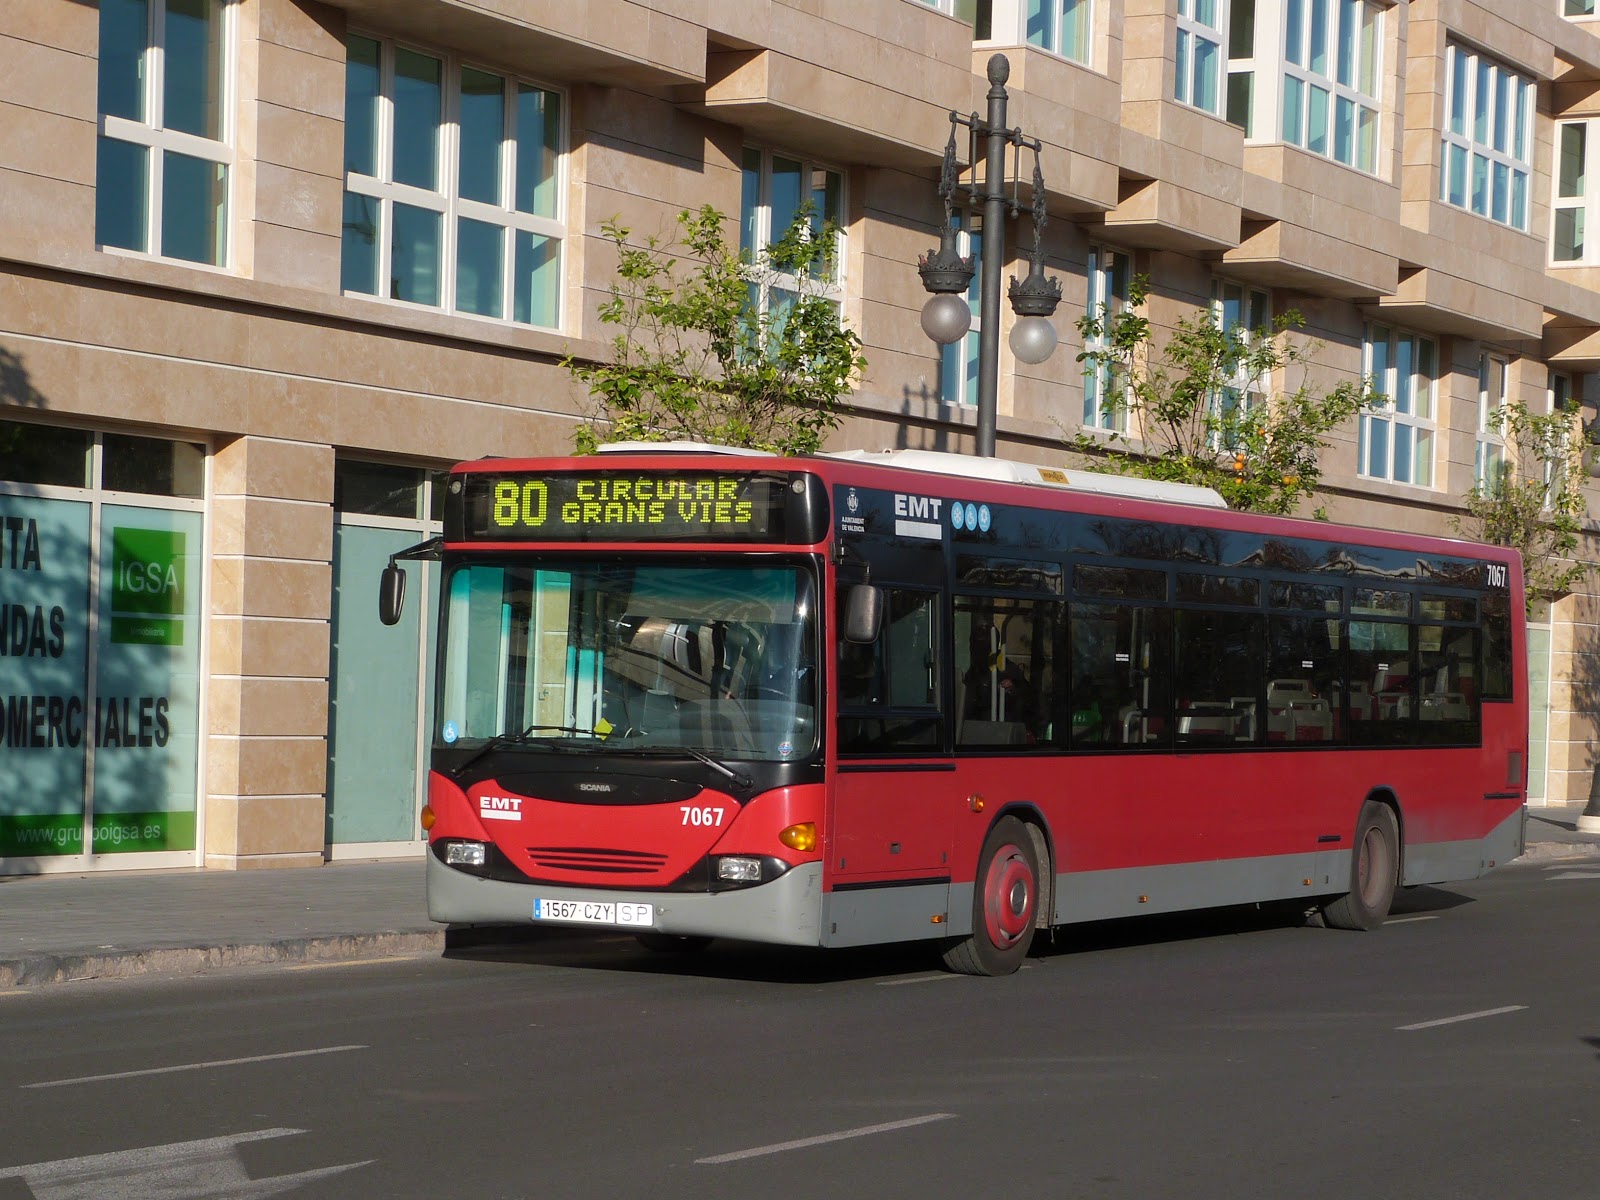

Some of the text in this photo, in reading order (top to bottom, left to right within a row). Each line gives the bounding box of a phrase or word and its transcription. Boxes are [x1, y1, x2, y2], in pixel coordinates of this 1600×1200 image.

[576, 479, 738, 501] CIRCULAR
[493, 480, 548, 526] 80
[561, 502, 752, 523] GRANS VIES
[894, 494, 942, 520] EMT
[0, 515, 42, 571] TA
[119, 560, 180, 595] IGSA
[1487, 564, 1506, 588] 7067
[580, 783, 611, 792] SCANIA
[479, 796, 522, 811] EMT
[680, 807, 724, 827] 7067
[546, 902, 577, 918] 1567
[584, 904, 611, 920] CZY
